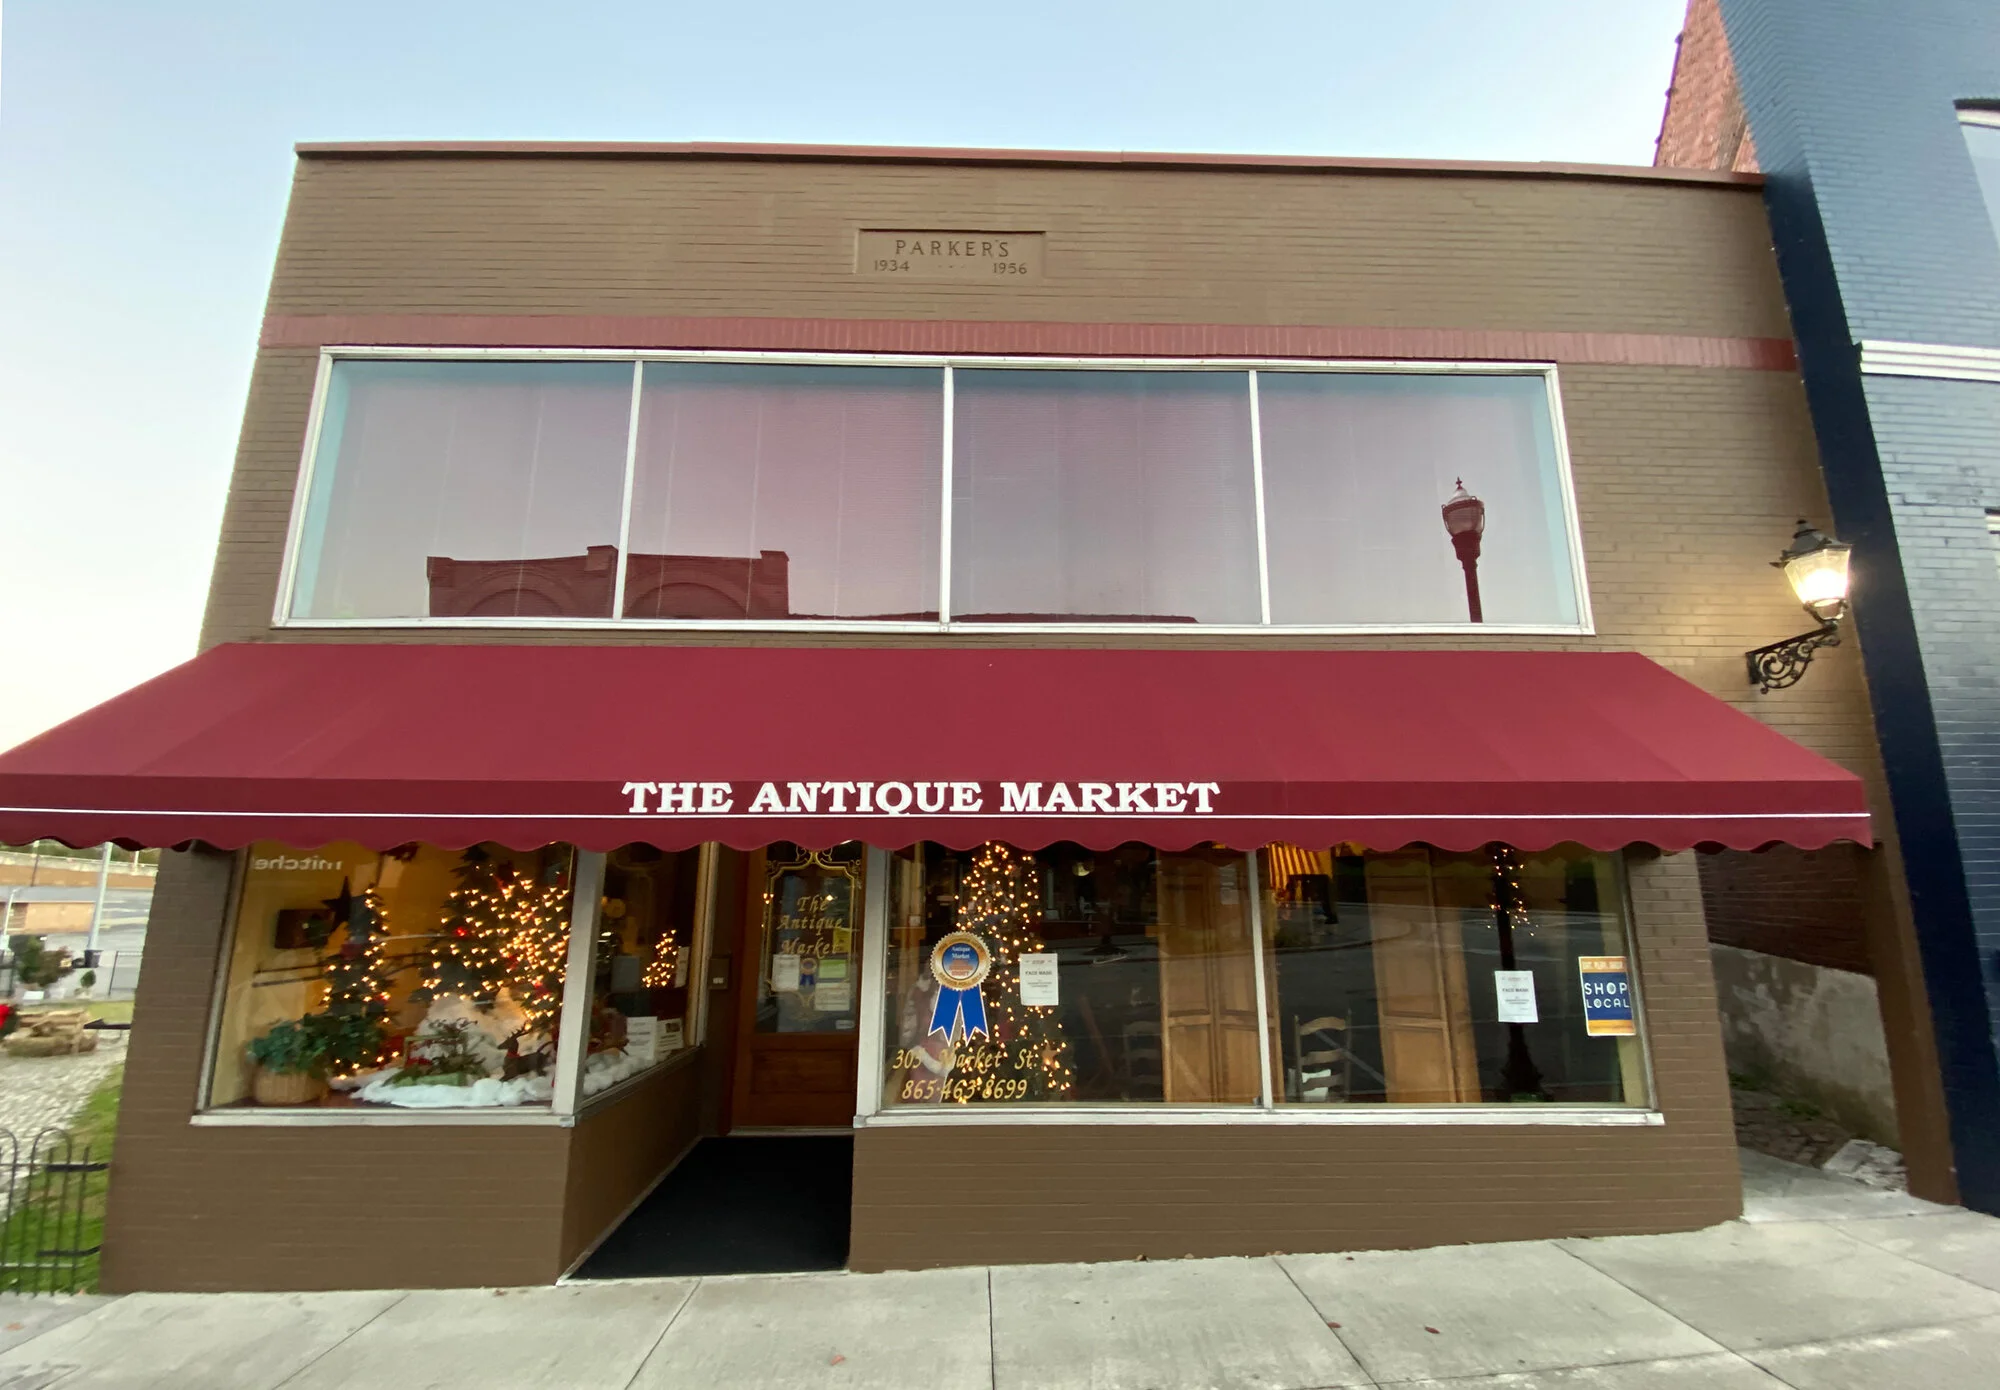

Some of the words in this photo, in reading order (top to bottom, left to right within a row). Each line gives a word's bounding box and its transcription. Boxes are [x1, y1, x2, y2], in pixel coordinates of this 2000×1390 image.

[873, 260, 910, 272] 1934
[992, 262, 1028, 275] 1956
[621, 781, 734, 813] THE
[748, 781, 984, 816] ANTIQUE
[999, 781, 1221, 813] MARKET
[797, 895, 829, 912] The
[777, 915, 842, 936] Antique
[781, 937, 840, 959] Market
[1584, 982, 1628, 995] SHOP
[1586, 998, 1631, 1009] LOCAL
